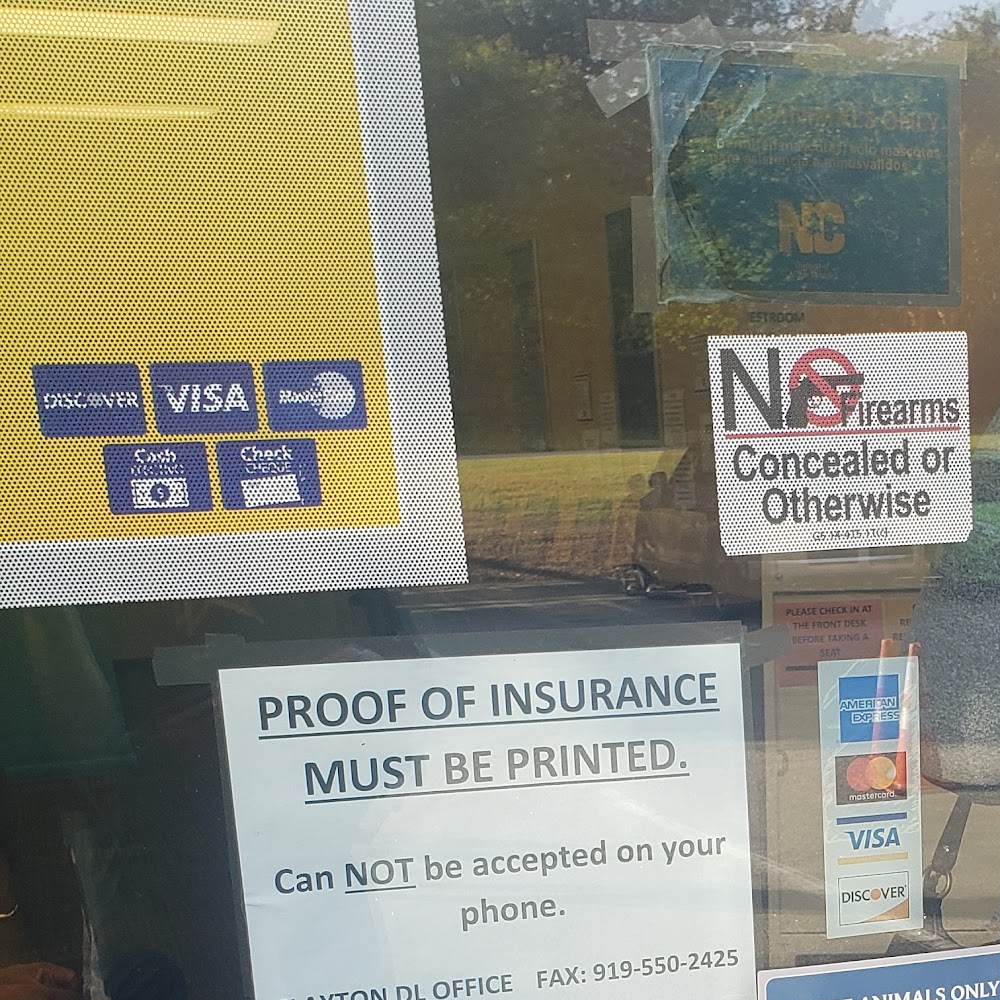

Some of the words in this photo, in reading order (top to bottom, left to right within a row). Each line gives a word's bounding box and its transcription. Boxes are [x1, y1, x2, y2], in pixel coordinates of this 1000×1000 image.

[778, 201, 845, 254] NC
[750, 311, 804, 323] ESTROOM
[157, 383, 250, 413] VISA
[839, 391, 961, 427] Firearms
[134, 448, 177, 464] Cash
[240, 445, 294, 461] Check
[733, 438, 911, 482] Concealed
[920, 445, 956, 476] or
[762, 483, 932, 525] Otherwise
[785, 606, 817, 617] PLEASE
[819, 606, 848, 616] CHECK
[849, 605, 860, 614] IN
[861, 604, 872, 613] AT
[792, 621, 810, 630] THE
[812, 620, 841, 629] FRONT
[844, 619, 867, 628] DESK
[792, 634, 825, 645] BEFORE
[827, 633, 860, 643] TAKING
[862, 633, 869, 641] A
[259, 688, 407, 731] PROOF
[421, 685, 476, 721] OF
[491, 672, 719, 717] INSURANCE
[840, 698, 896, 711] AMERICAN
[852, 710, 900, 724] EXPRESS
[304, 753, 430, 796] MUST
[445, 750, 494, 785] BE
[508, 739, 688, 780] PRINTED.
[844, 827, 900, 850] VISA
[274, 866, 334, 895] Can
[344, 857, 415, 888] NOT
[425, 853, 463, 881] be
[473, 839, 607, 876] accepted
[616, 842, 653, 864] on
[661, 834, 727, 866] your
[841, 885, 906, 904] DISCOVER
[461, 896, 567, 932] phone.
[536, 966, 587, 990] FAX:
[592, 948, 740, 983] 919-550-2425
[432, 974, 514, 1000] OFFICE
